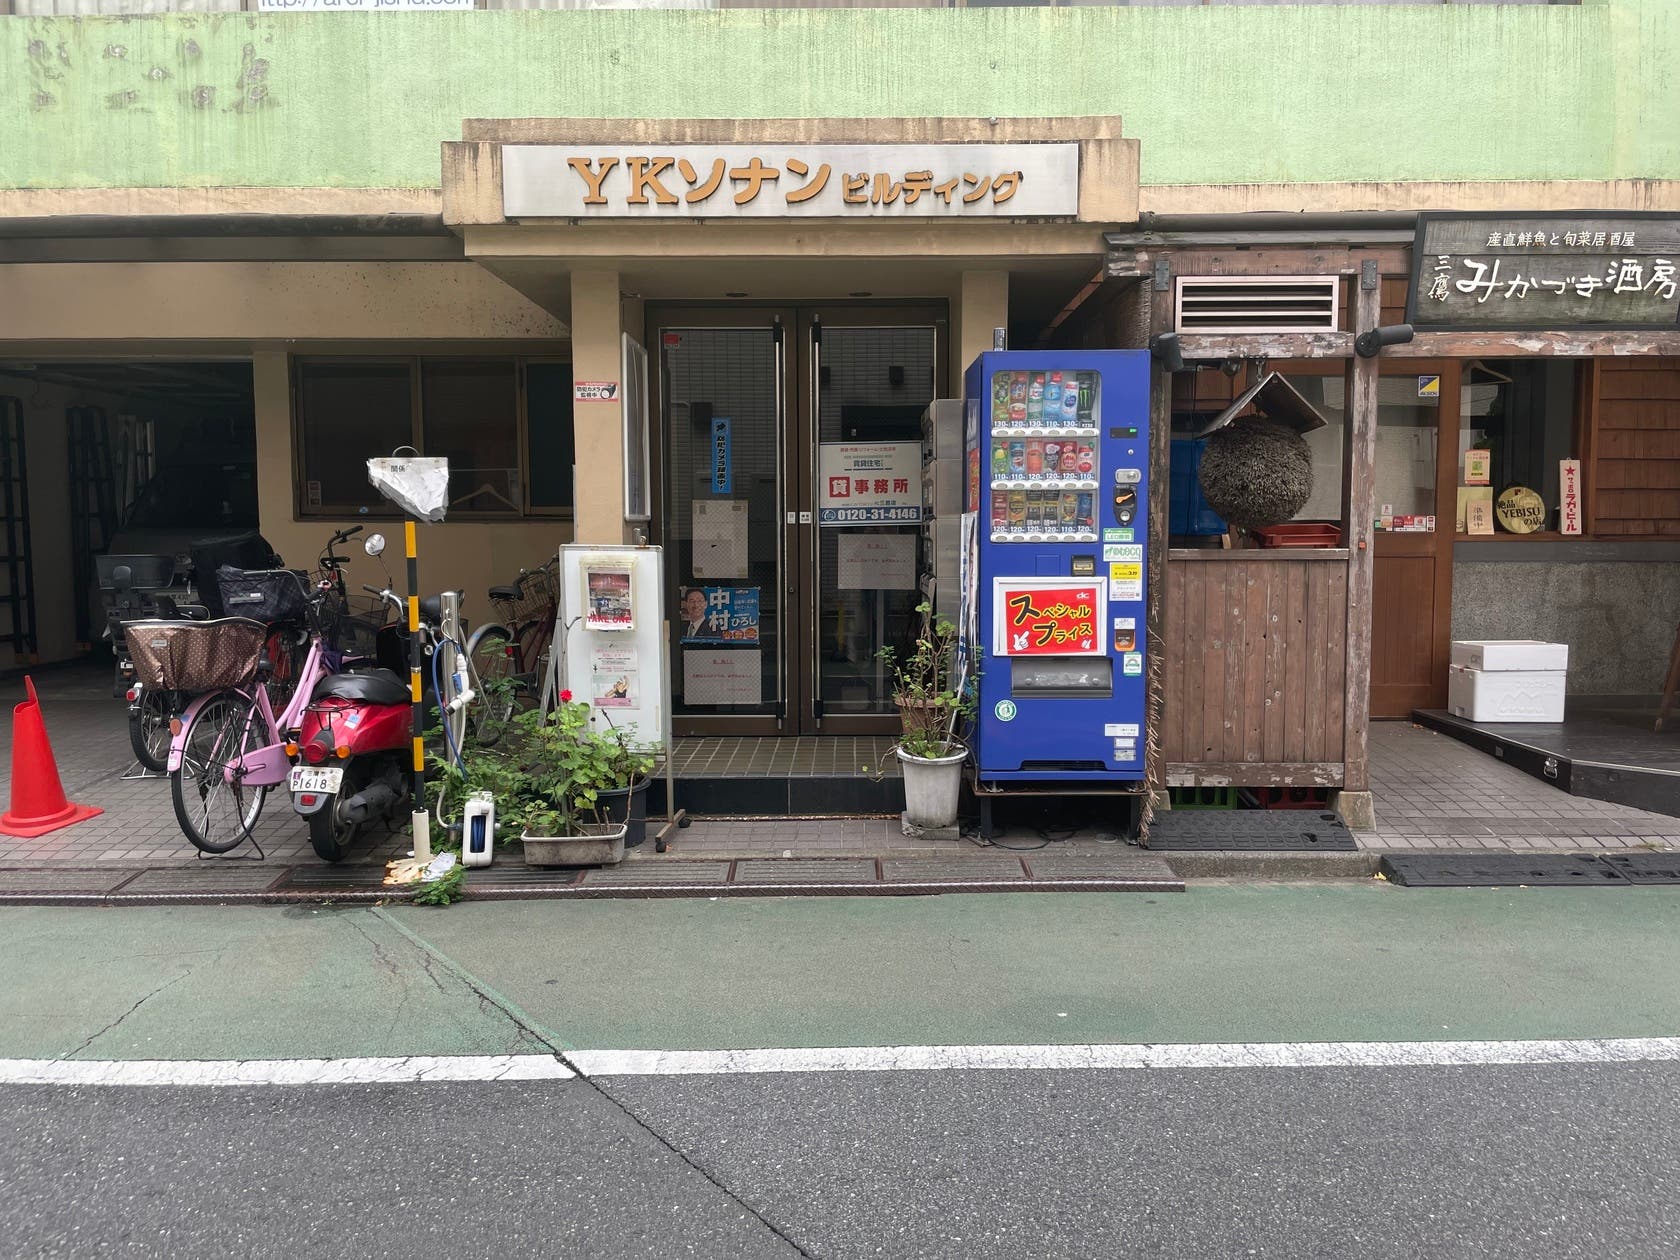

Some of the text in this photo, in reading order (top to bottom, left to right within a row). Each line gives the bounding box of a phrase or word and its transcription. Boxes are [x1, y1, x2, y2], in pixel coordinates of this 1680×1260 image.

[1486, 231, 1636, 248] 産直鮮魚と旬菜居酒屋
[1455, 257, 1678, 303] みかづき酒房
[837, 508, 917, 520] 0120-31-4146
[1501, 507, 1541, 518] YEBISU
[709, 588, 730, 632] 中村
[1009, 594, 1092, 625] スペシャル
[587, 615, 610, 623] TAKE
[731, 616, 757, 627] ひろし
[1032, 621, 1093, 645] プライス
